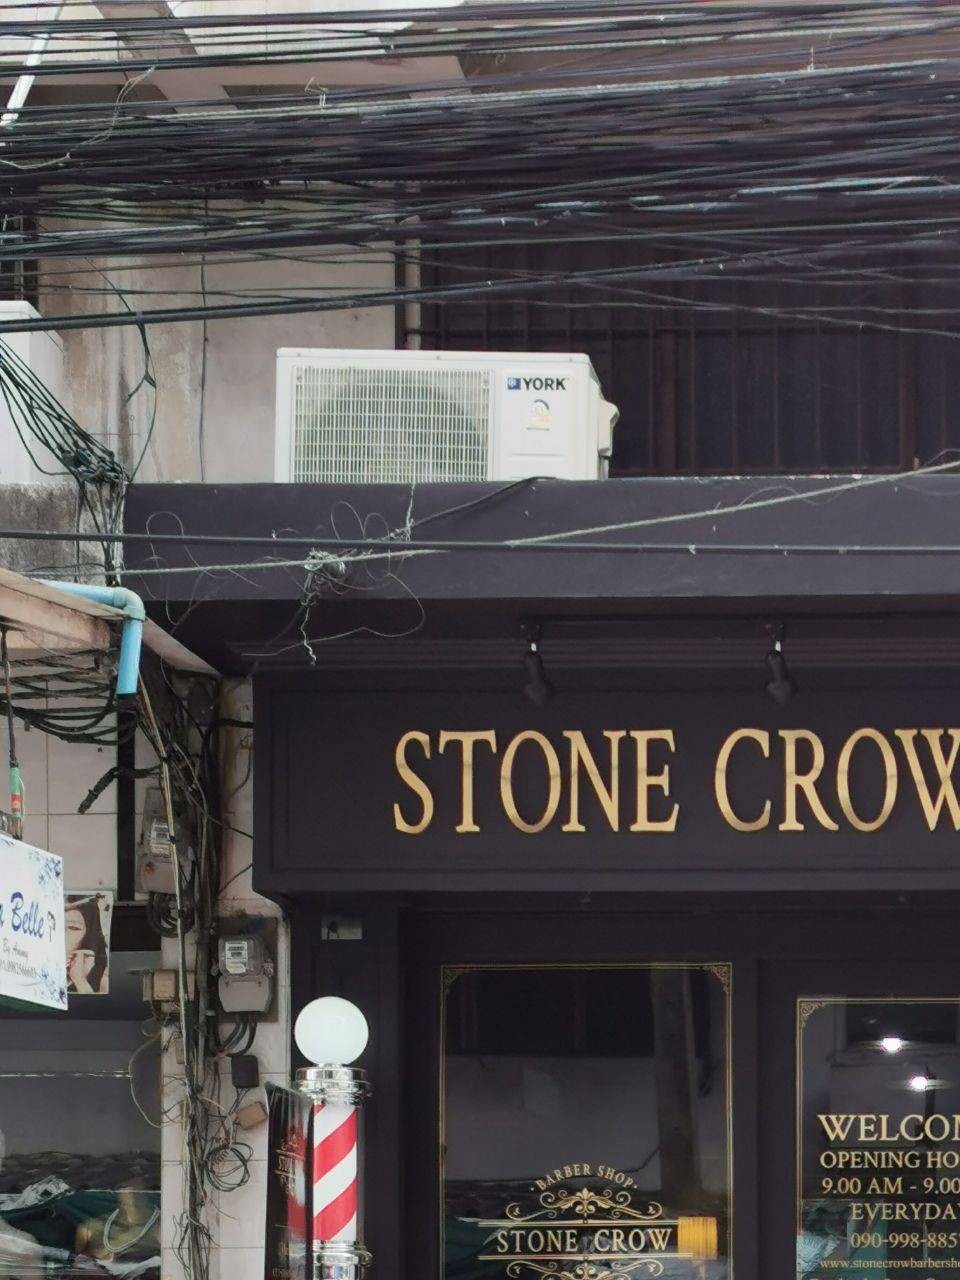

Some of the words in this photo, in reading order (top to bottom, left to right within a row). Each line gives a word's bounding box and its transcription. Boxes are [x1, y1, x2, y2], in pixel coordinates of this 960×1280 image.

[523, 377, 567, 391] YORK
[393, 729, 680, 835] STONE
[11, 892, 44, 939] Belle
[820, 1151, 921, 1169] OPENING
[535, 1163, 591, 1191] BARBER
[597, 1165, 634, 1188] SHOP
[821, 1177, 862, 1194] 9.00
[866, 1177, 903, 1194] AM
[496, 1229, 578, 1253] STONE
[594, 1228, 672, 1251] CROW
